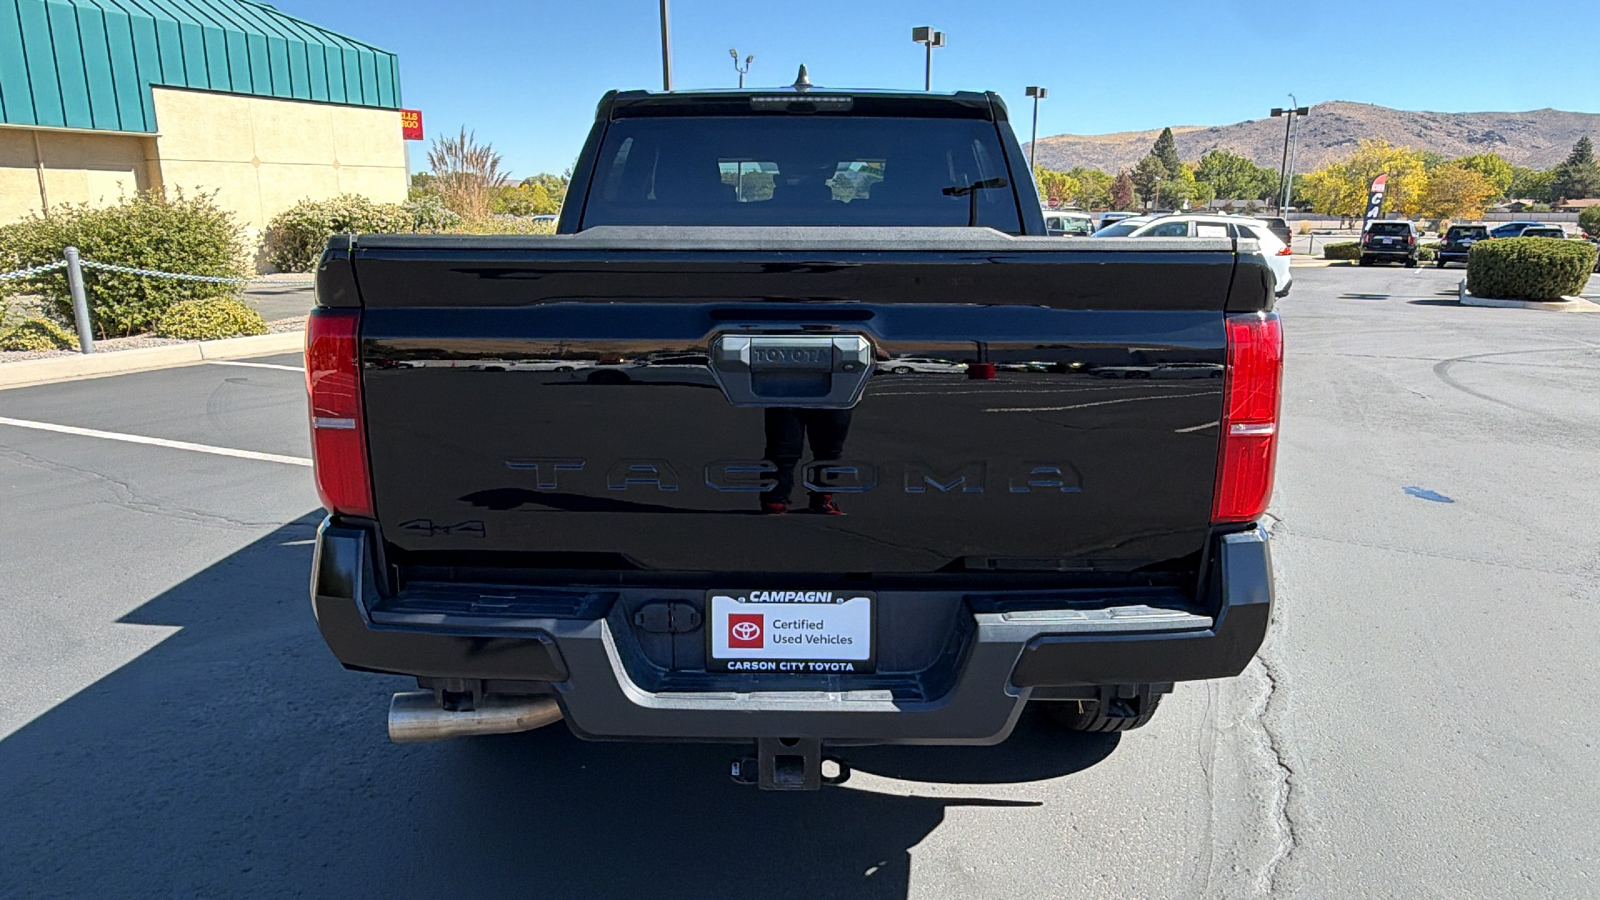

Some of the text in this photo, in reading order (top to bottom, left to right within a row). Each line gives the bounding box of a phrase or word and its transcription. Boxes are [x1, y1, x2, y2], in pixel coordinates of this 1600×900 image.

[754, 349, 829, 363] TOYOTA
[505, 456, 1083, 493] TACOMA
[750, 591, 833, 603] CAMPAGNI
[772, 619, 824, 630] Certified
[773, 634, 853, 645] Used Vehicles
[727, 661, 855, 671] CARSON CITY TOYOTA
